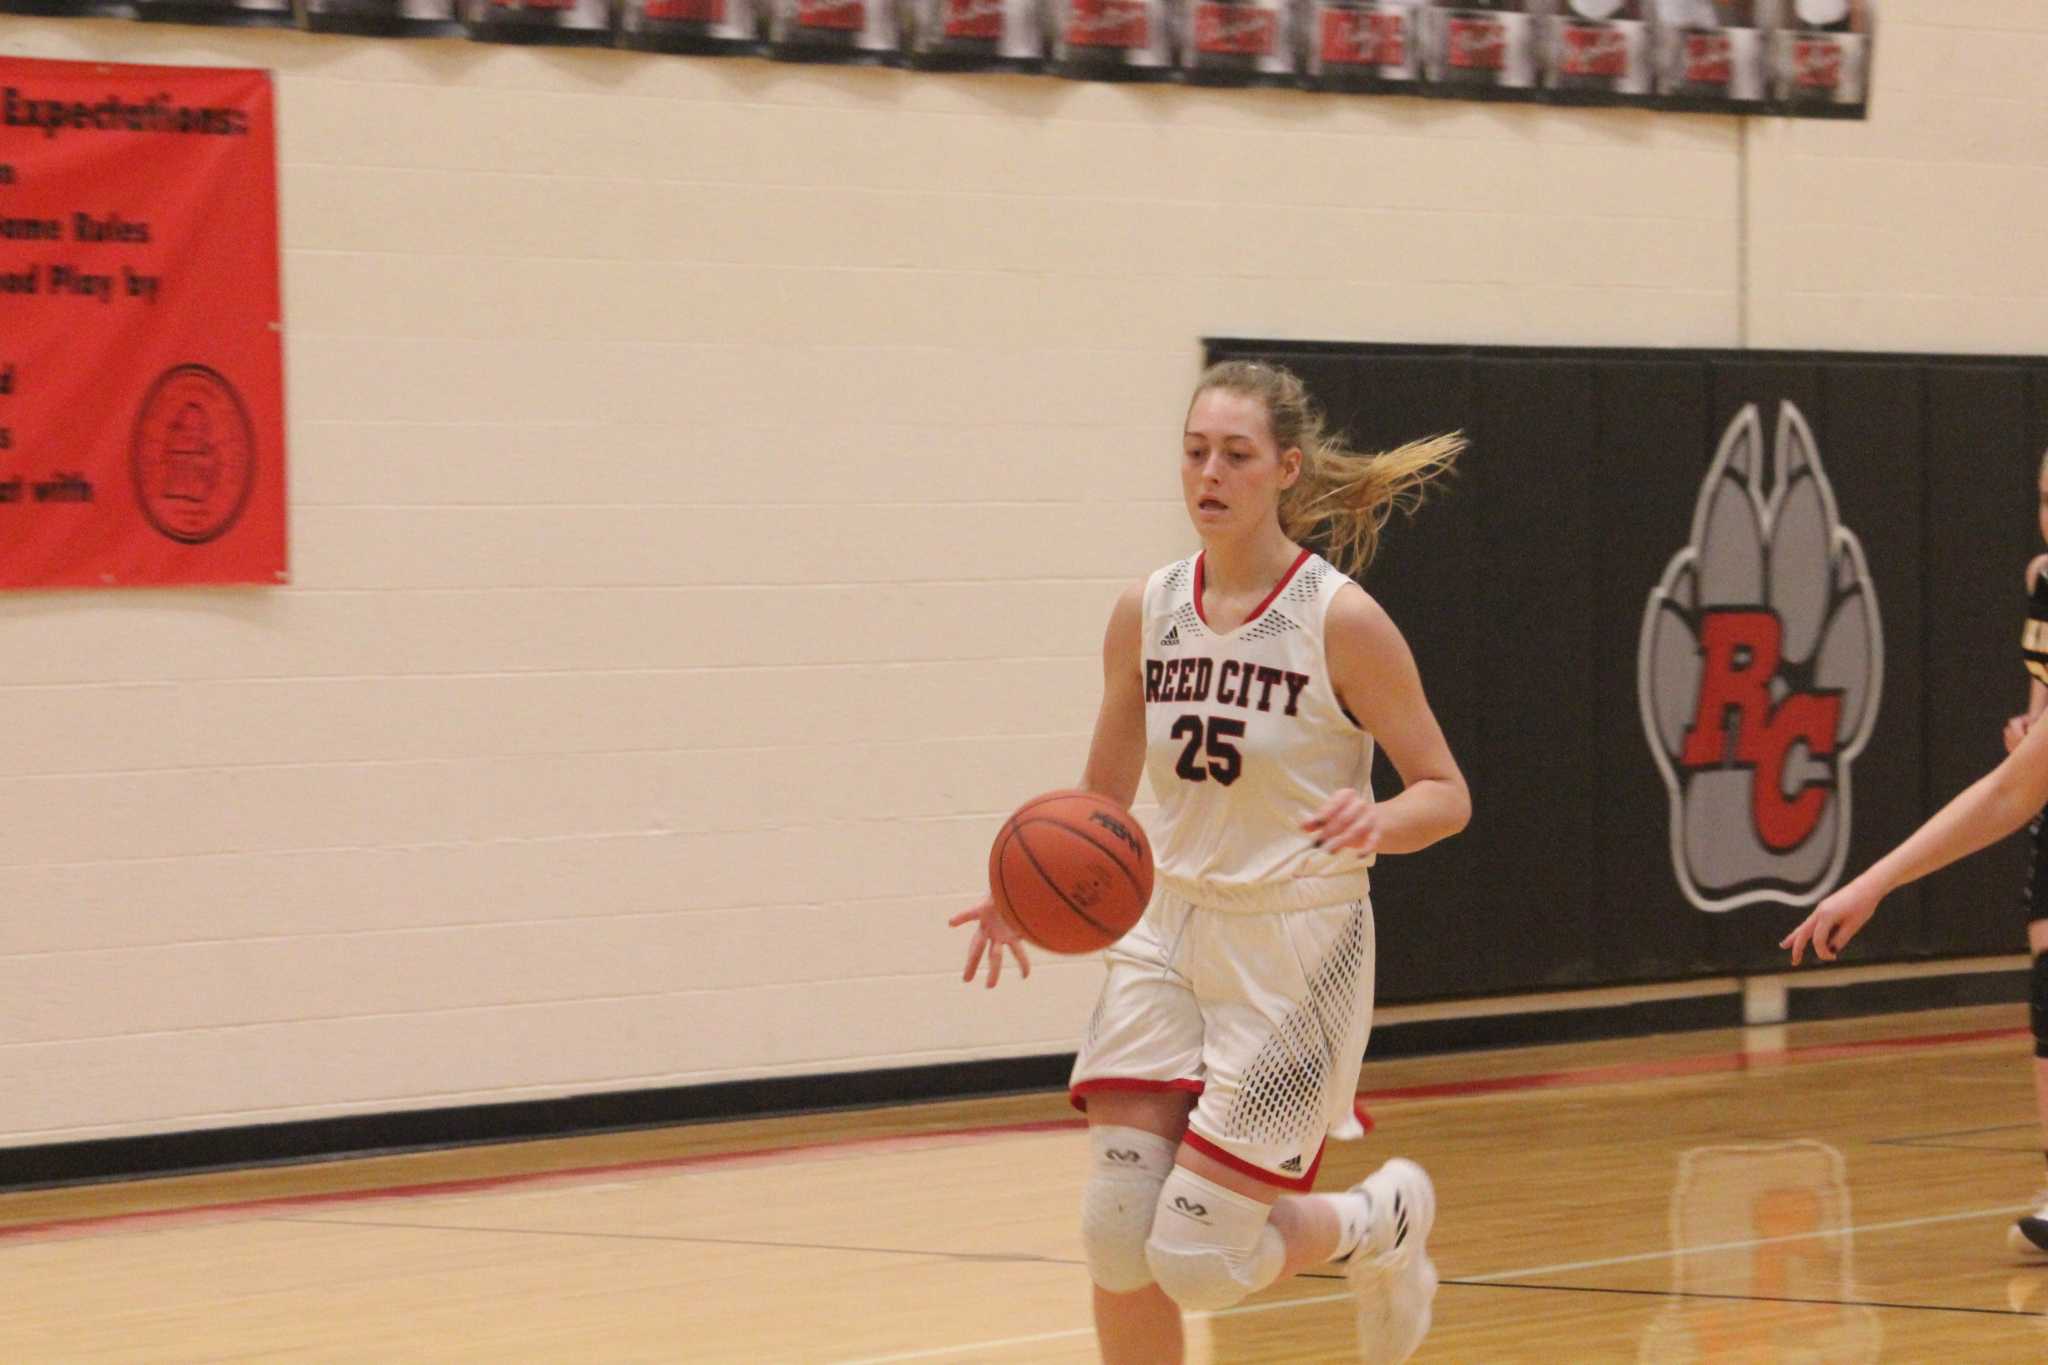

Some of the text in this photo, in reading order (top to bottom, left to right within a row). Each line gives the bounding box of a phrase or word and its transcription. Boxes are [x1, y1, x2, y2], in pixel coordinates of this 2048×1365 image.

[1145, 657, 1310, 716] REED CITY
[1170, 714, 1247, 786] 25
[1680, 610, 1842, 850] RC
